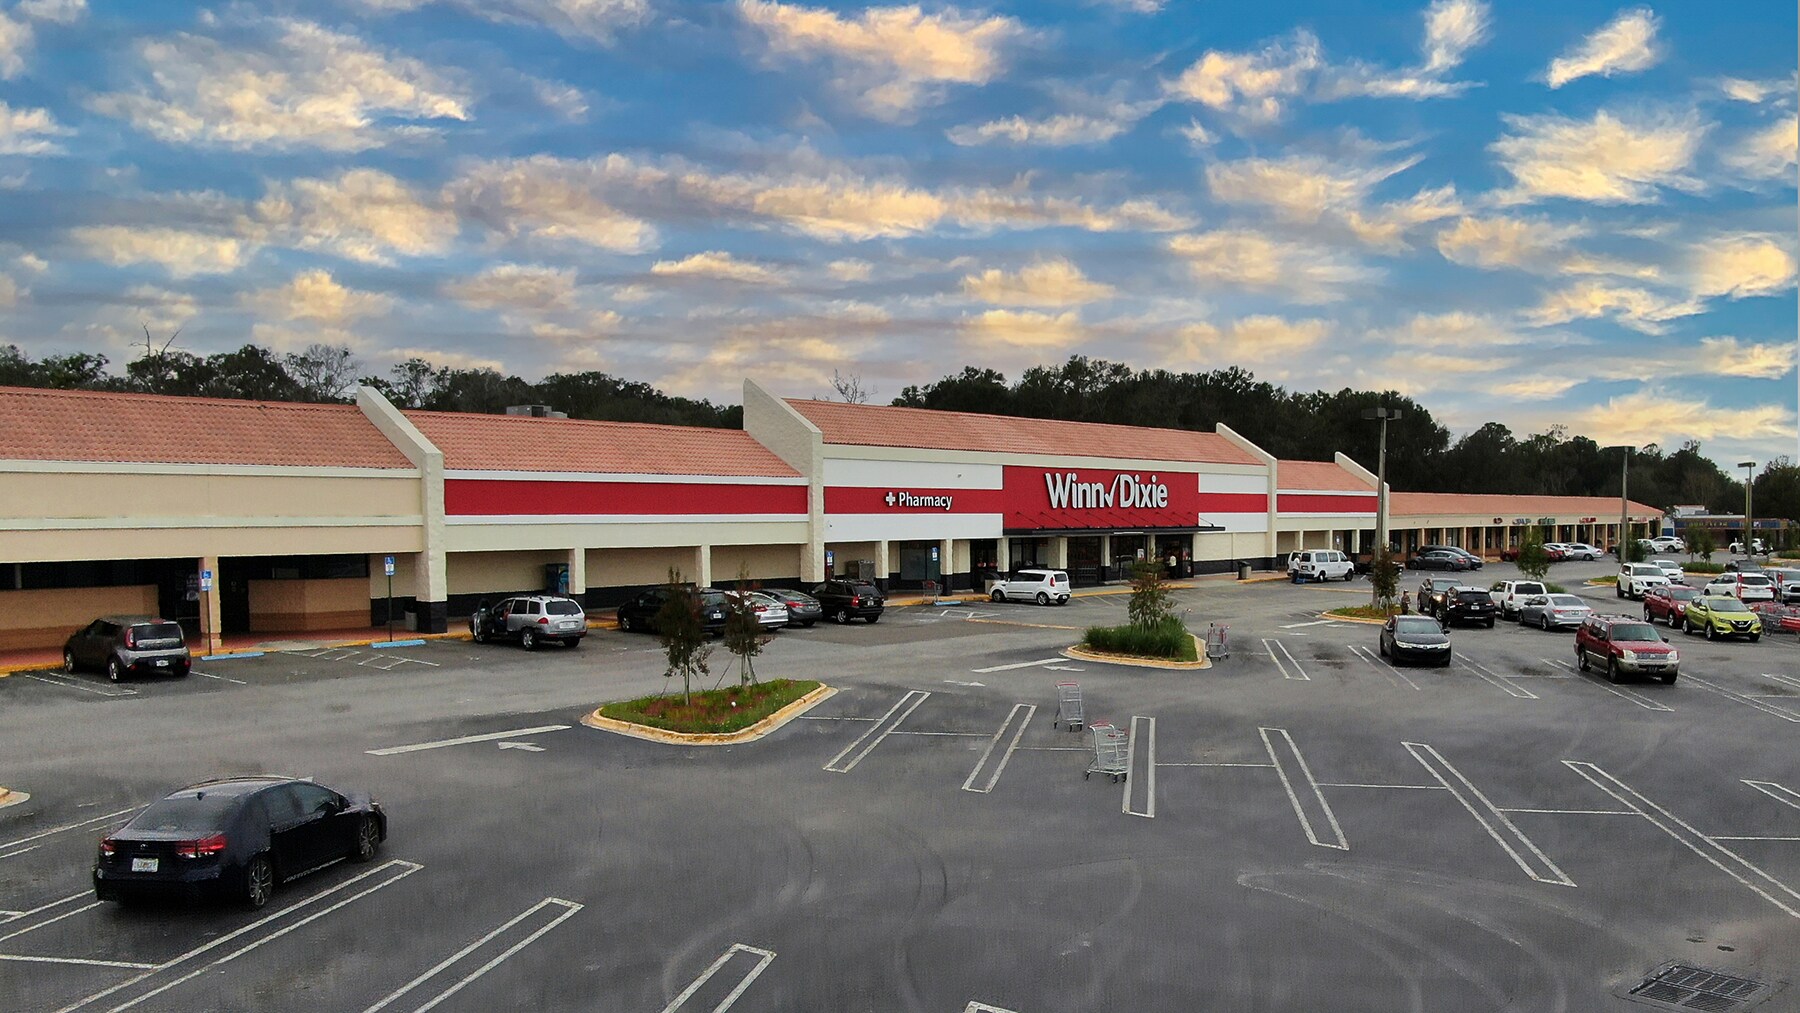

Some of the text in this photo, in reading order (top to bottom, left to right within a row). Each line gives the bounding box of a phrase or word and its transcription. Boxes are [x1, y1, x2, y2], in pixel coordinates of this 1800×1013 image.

[898, 491, 953, 511] Pharmacy
[1044, 472, 1168, 509] Winn Dixie
